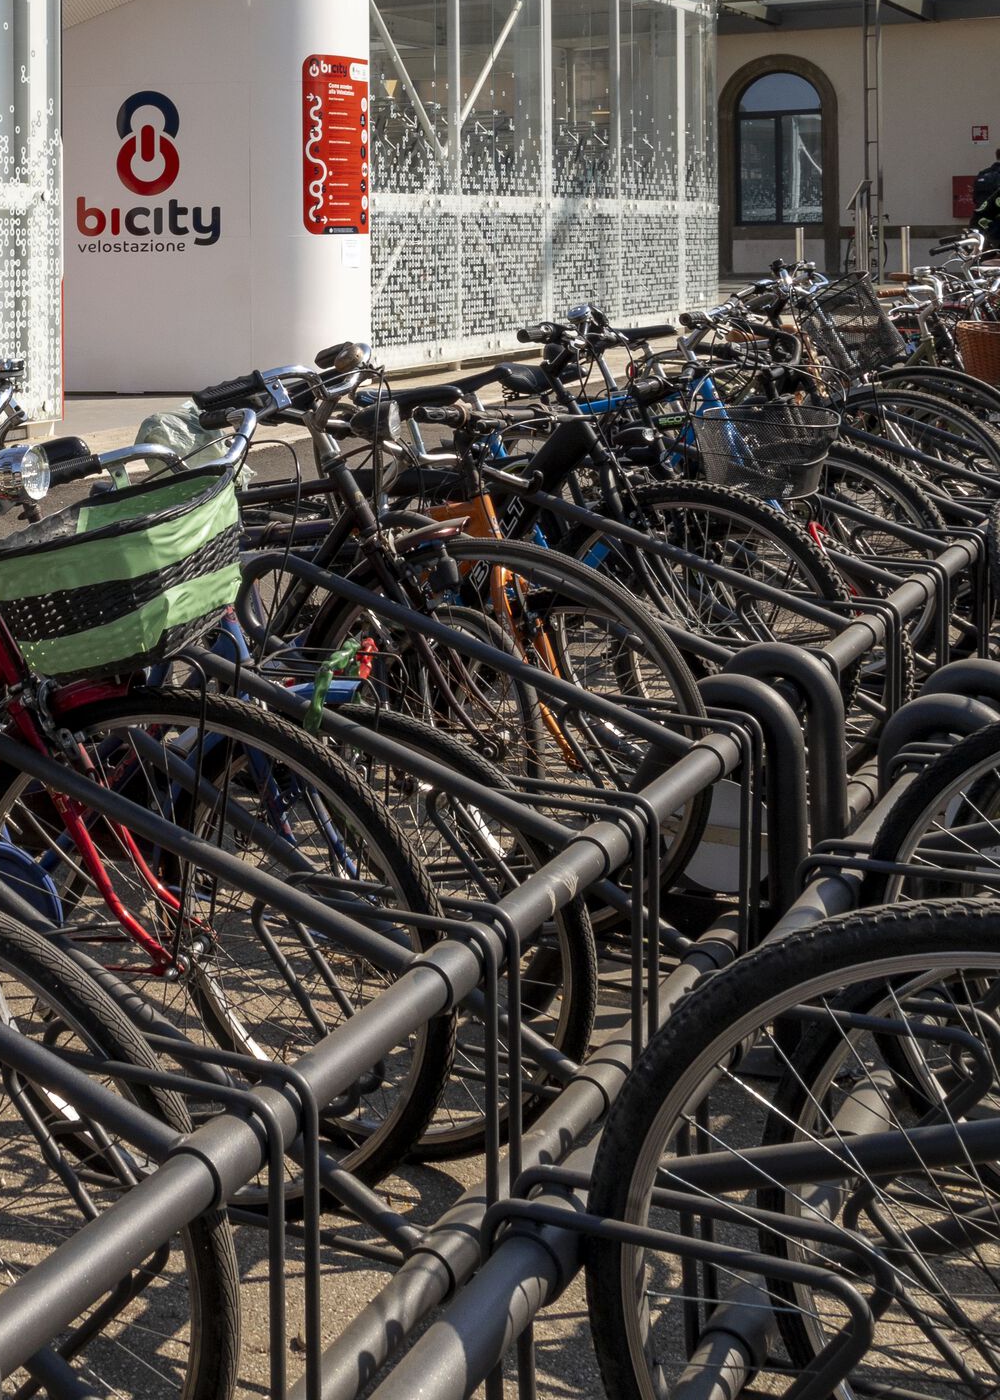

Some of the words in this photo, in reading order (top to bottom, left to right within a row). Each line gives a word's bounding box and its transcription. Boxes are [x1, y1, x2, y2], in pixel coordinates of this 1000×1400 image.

[320, 60, 348, 78] bicity
[76, 196, 221, 246] bicity
[77, 240, 186, 253] velostazione
